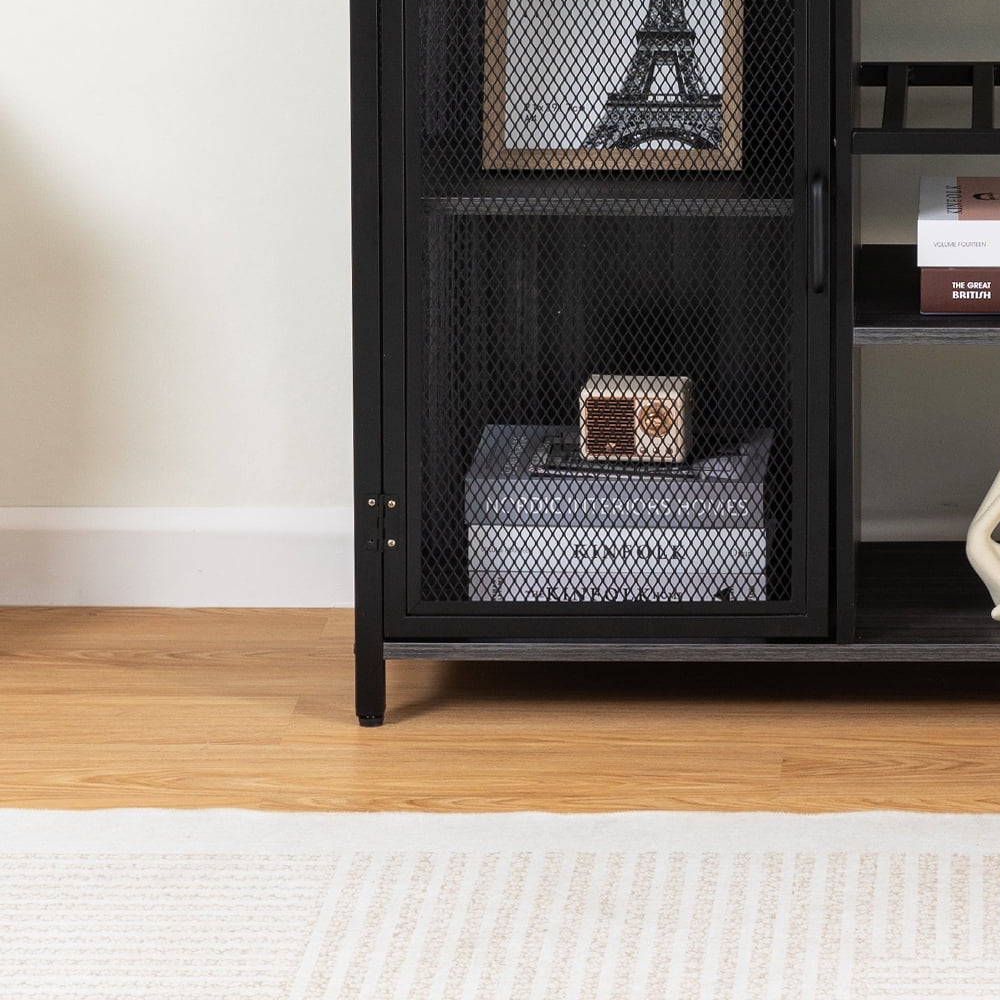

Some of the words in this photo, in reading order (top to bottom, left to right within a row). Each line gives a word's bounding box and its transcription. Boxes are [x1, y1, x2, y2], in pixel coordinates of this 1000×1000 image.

[946, 185, 963, 215] KINFOLK
[952, 281, 966, 289] THE
[967, 281, 991, 289] GREAT
[952, 291, 992, 299] BRITISH
[574, 543, 687, 560] KINFOLK
